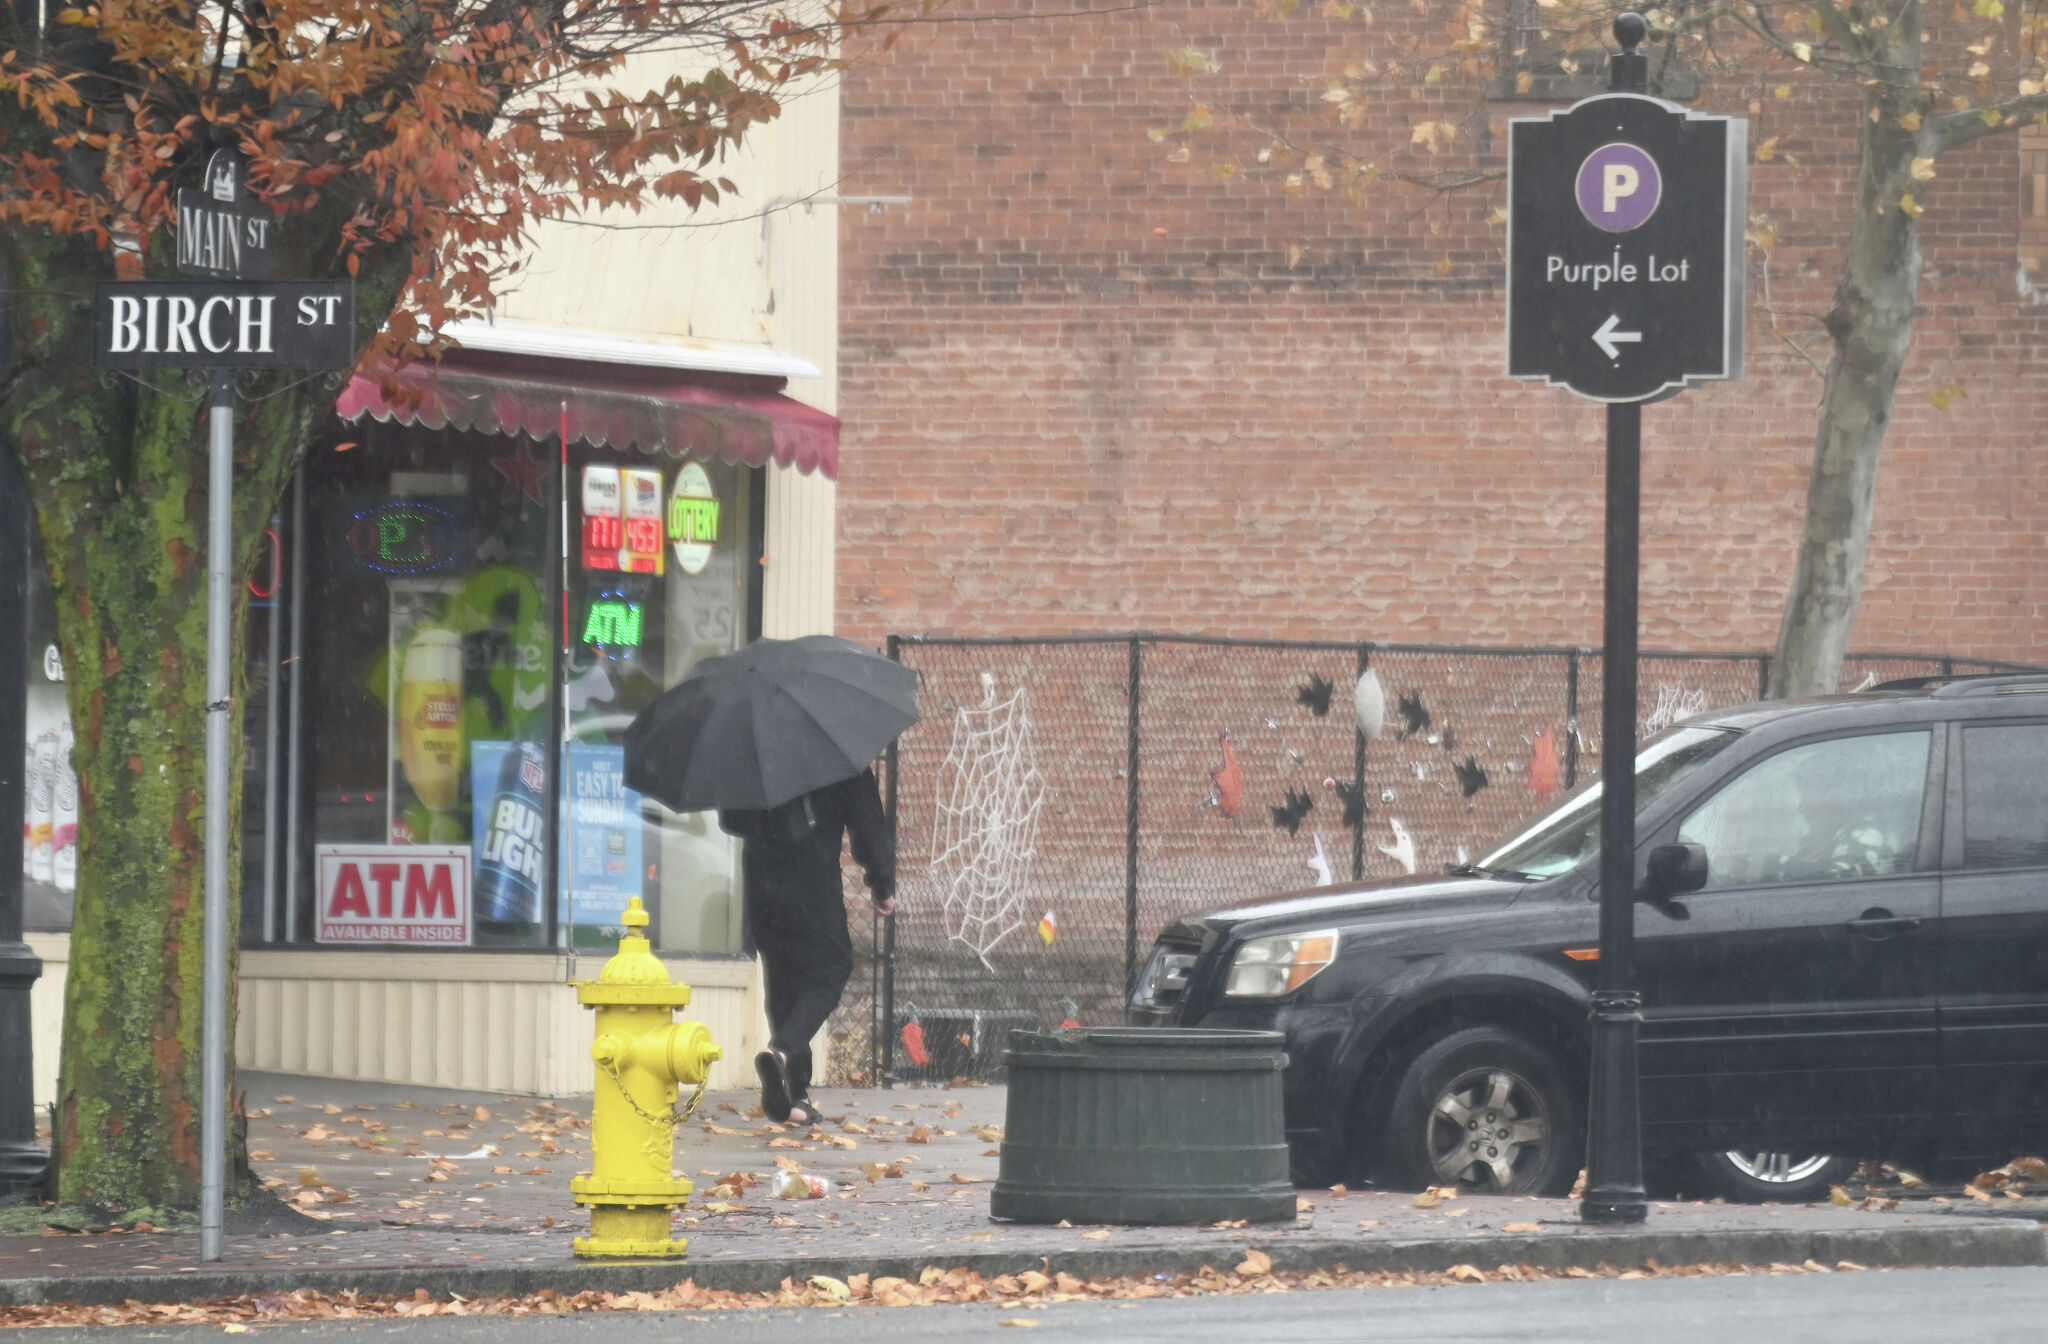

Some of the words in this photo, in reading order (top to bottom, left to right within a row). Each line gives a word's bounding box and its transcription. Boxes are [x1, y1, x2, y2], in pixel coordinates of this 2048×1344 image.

[1603, 164, 1639, 212] P
[182, 206, 242, 274] MAIN
[247, 217, 268, 249] ST
[1547, 251, 1637, 291] Purple
[1648, 255, 1690, 282] Lot
[108, 295, 276, 353] BIRCH
[297, 295, 342, 326] ST
[592, 517, 618, 549] 171
[626, 520, 658, 553] 453
[667, 497, 721, 542] LOTTERY
[583, 602, 641, 645] ATM
[523, 760, 544, 788] NFL
[576, 771, 608, 797] EASY
[610, 773, 625, 798] TO
[577, 799, 625, 824] SUNDAY
[481, 830, 543, 885] LIGH
[327, 862, 456, 919] ATM
[324, 925, 407, 940] AVAILABLE
[411, 926, 463, 940] INSIDE
